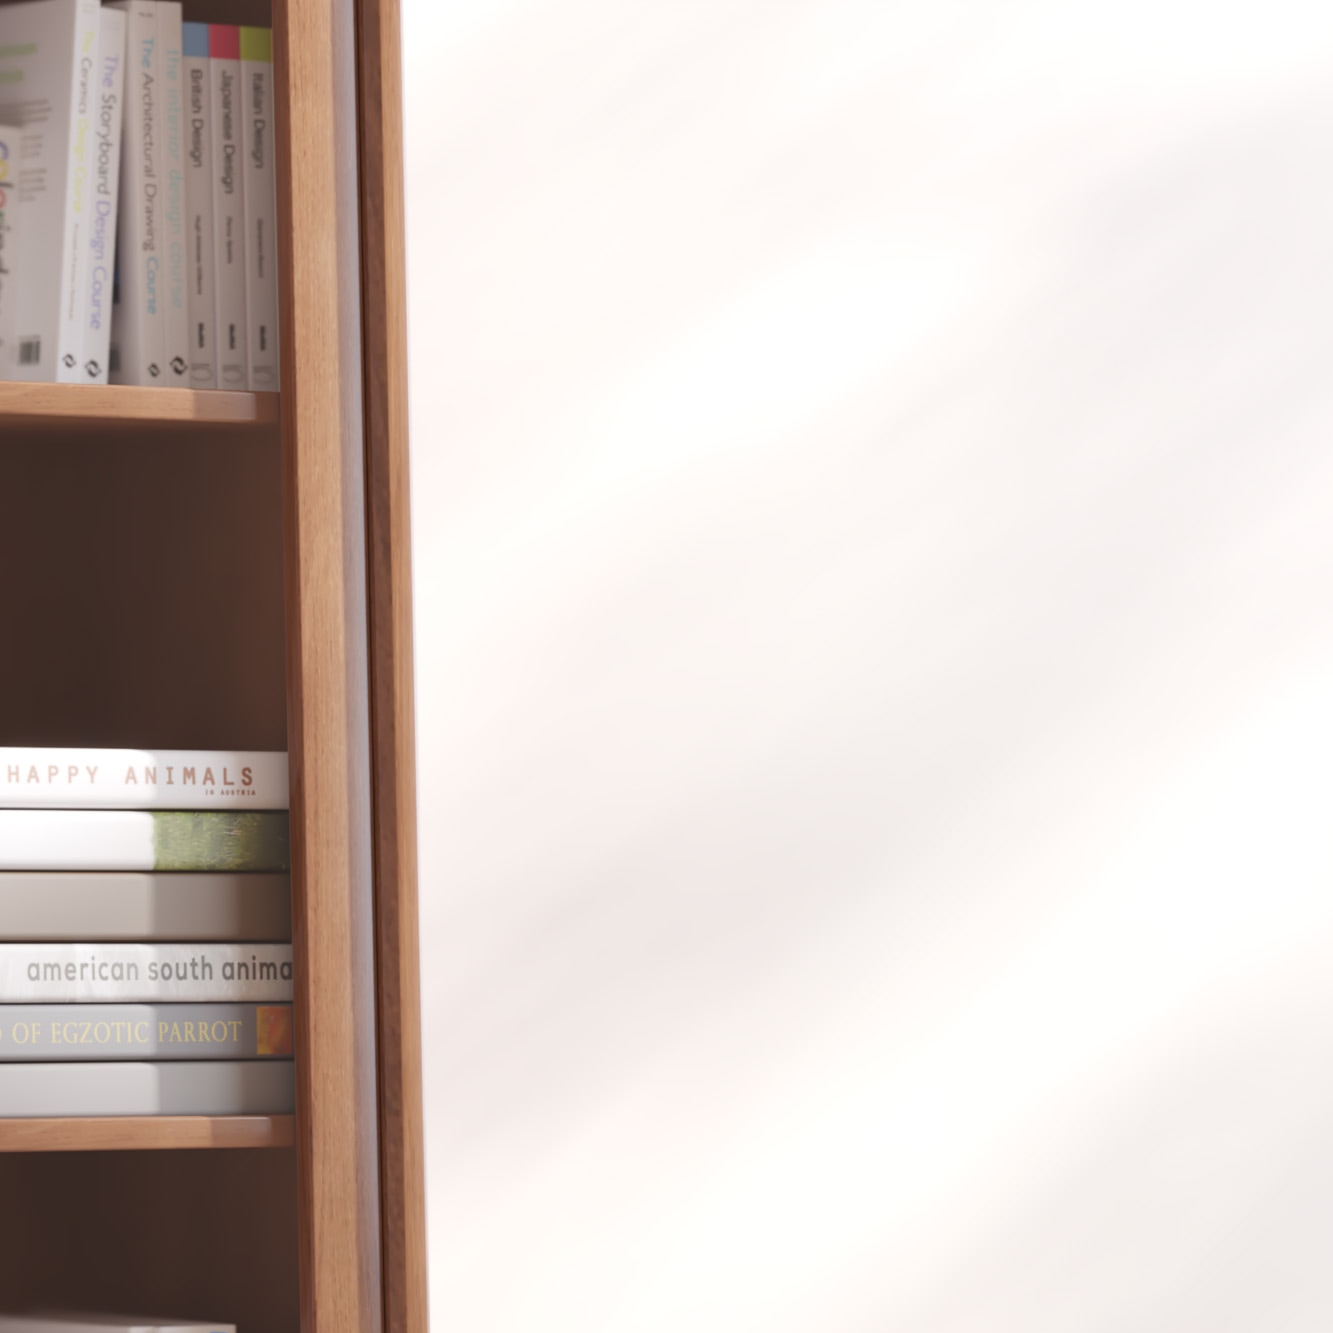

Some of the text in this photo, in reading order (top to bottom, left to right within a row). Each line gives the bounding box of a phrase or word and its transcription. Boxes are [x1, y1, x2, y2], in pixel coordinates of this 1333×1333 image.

[78, 57, 93, 114] Ceramics
[189, 68, 206, 168] British Design
[219, 70, 237, 195] Japanese Design
[251, 72, 267, 169] Italian Design
[90, 55, 119, 330] The Storyboard Design Course
[140, 37, 160, 315] The Architectural Drawing Course
[165, 50, 186, 309] the interior design course
[7, 764, 254, 786] HAPPY ANIMALS
[221, 789, 257, 797] AUSTRIA
[27, 956, 139, 982] american
[148, 955, 213, 981] south
[12, 1020, 243, 1044] OF EGZOTIC PARROT
